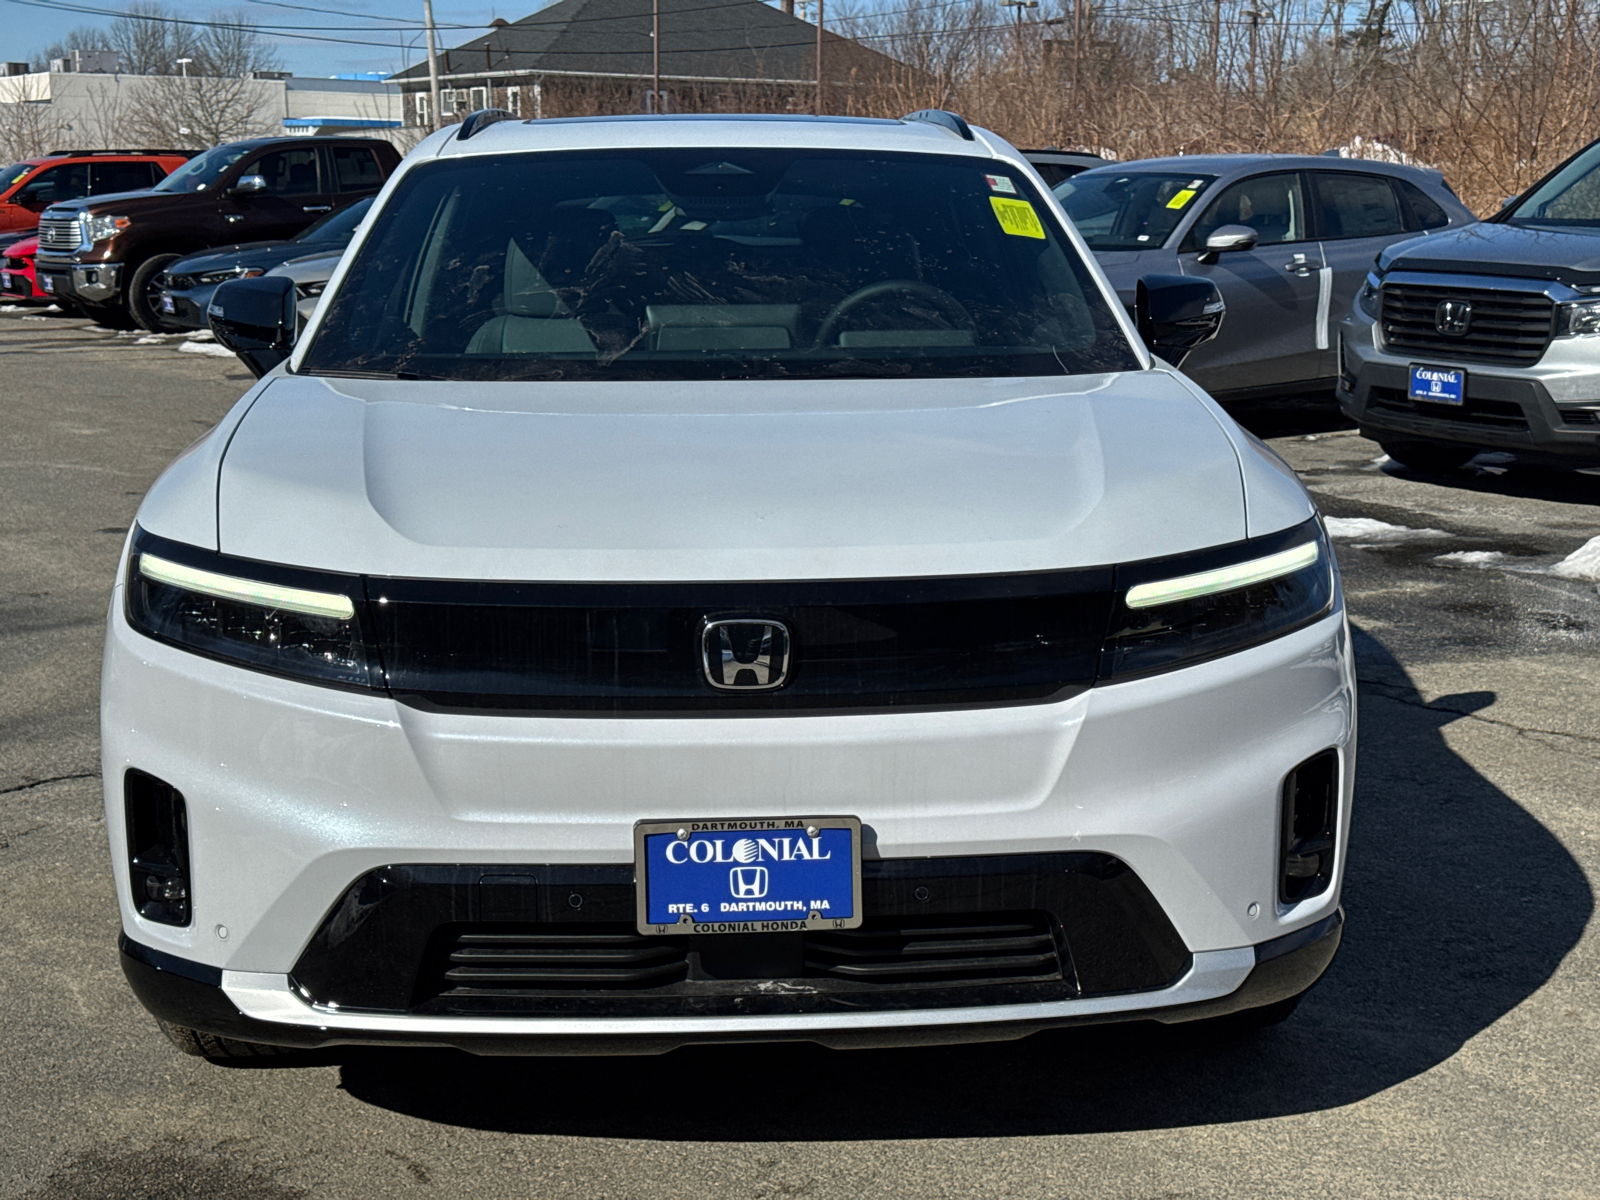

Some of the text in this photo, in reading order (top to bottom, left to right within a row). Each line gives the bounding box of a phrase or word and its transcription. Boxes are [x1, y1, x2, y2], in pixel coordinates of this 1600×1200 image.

[691, 820, 804, 831] DARTMOUTH, MA
[665, 837, 831, 864] COLONIAL
[668, 900, 831, 913] RTE. 6 DARTMOUTH, MA
[693, 921, 807, 933] COLONIAL HONDA
